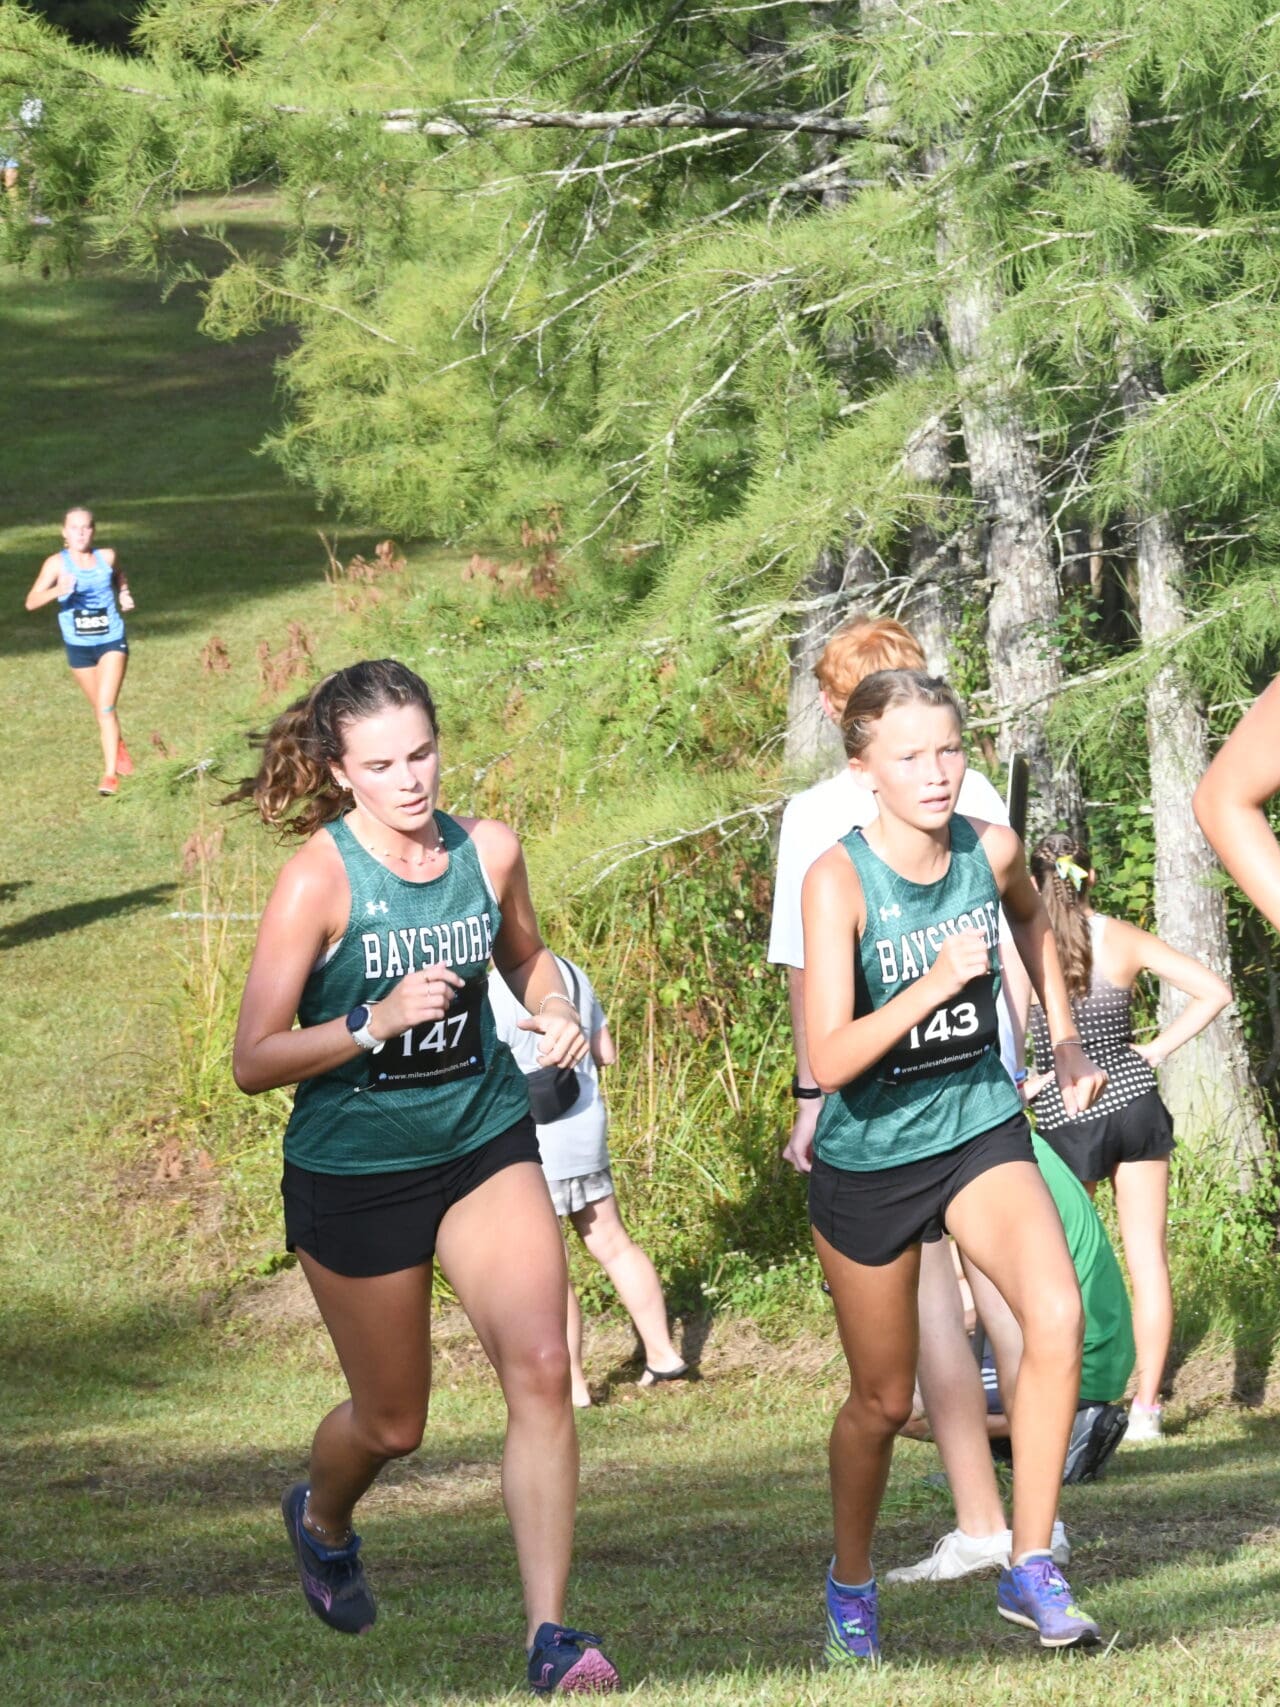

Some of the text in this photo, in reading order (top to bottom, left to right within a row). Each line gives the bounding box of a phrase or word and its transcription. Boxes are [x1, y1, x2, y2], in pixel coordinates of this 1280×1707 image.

[361, 912, 493, 979] BAYSHORE
[400, 1010, 468, 1056] 147
[910, 1002, 979, 1049] 143
[902, 1048, 983, 1074] www.milesandminutes.net
